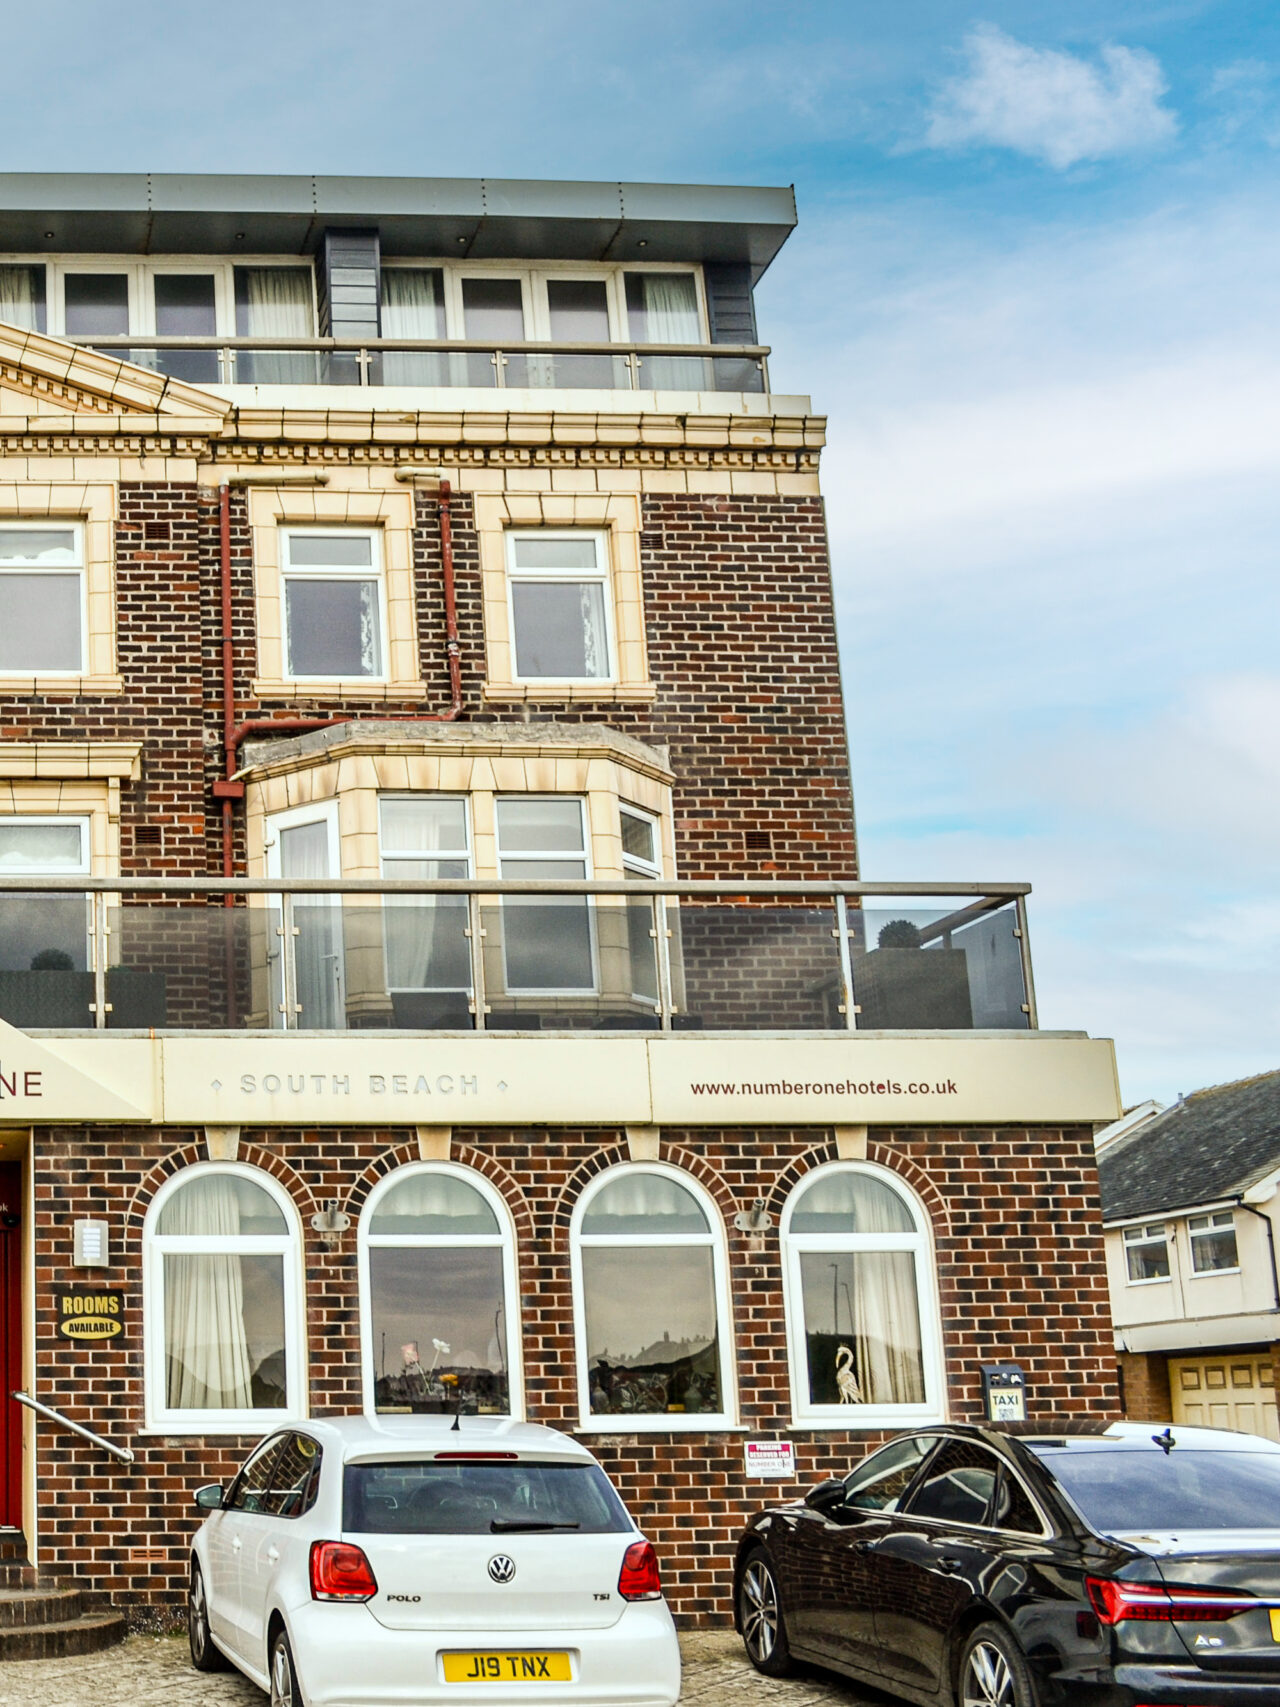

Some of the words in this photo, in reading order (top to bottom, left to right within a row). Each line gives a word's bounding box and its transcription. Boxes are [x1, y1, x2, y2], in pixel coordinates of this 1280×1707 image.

[240, 1074, 350, 1095] SOUTH
[369, 1074, 478, 1095] BEACH
[691, 1079, 958, 1095] www.numberonehotels.co.uk
[62, 1296, 119, 1315] ROOMS
[68, 1322, 114, 1333] AVAILABLE
[992, 1395, 1018, 1405] TAXI
[386, 1594, 422, 1603] POLO
[467, 1656, 500, 1678] J19
[506, 1656, 551, 1677] TNX
